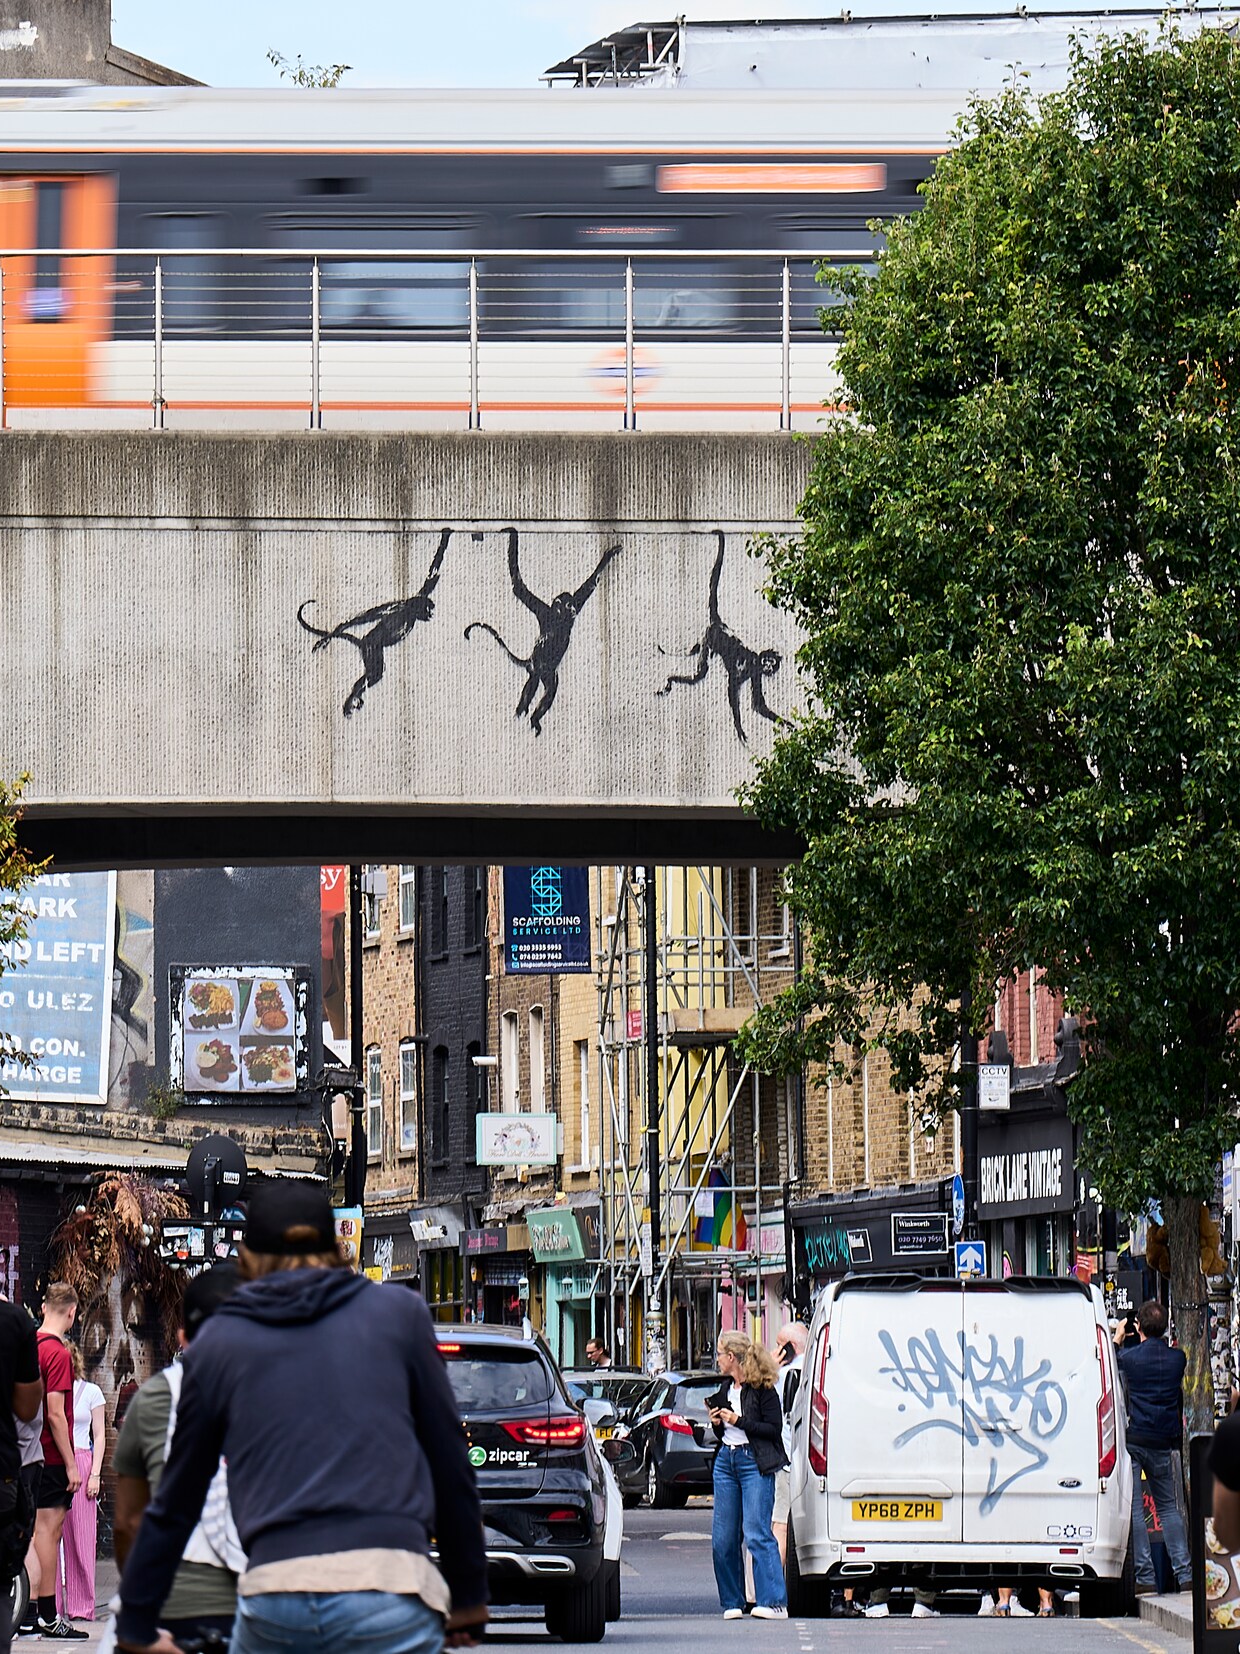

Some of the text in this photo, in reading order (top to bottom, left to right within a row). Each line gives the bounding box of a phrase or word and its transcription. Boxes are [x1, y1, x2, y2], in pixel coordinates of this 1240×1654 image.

[512, 916, 581, 927] SCAFFOLDING
[512, 926, 581, 936] SERVICE LTD
[36, 941, 105, 963] LEFT
[27, 990, 94, 1012] ULEZ
[29, 1037, 86, 1058] CON.
[981, 1067, 1007, 1076] CCTV
[980, 1148, 1062, 1204] BRICK LANE VINTAGE
[898, 1219, 930, 1228] Winkworth
[488, 1447, 530, 1465] zipcar
[859, 1502, 935, 1519] YP68 ZPH
